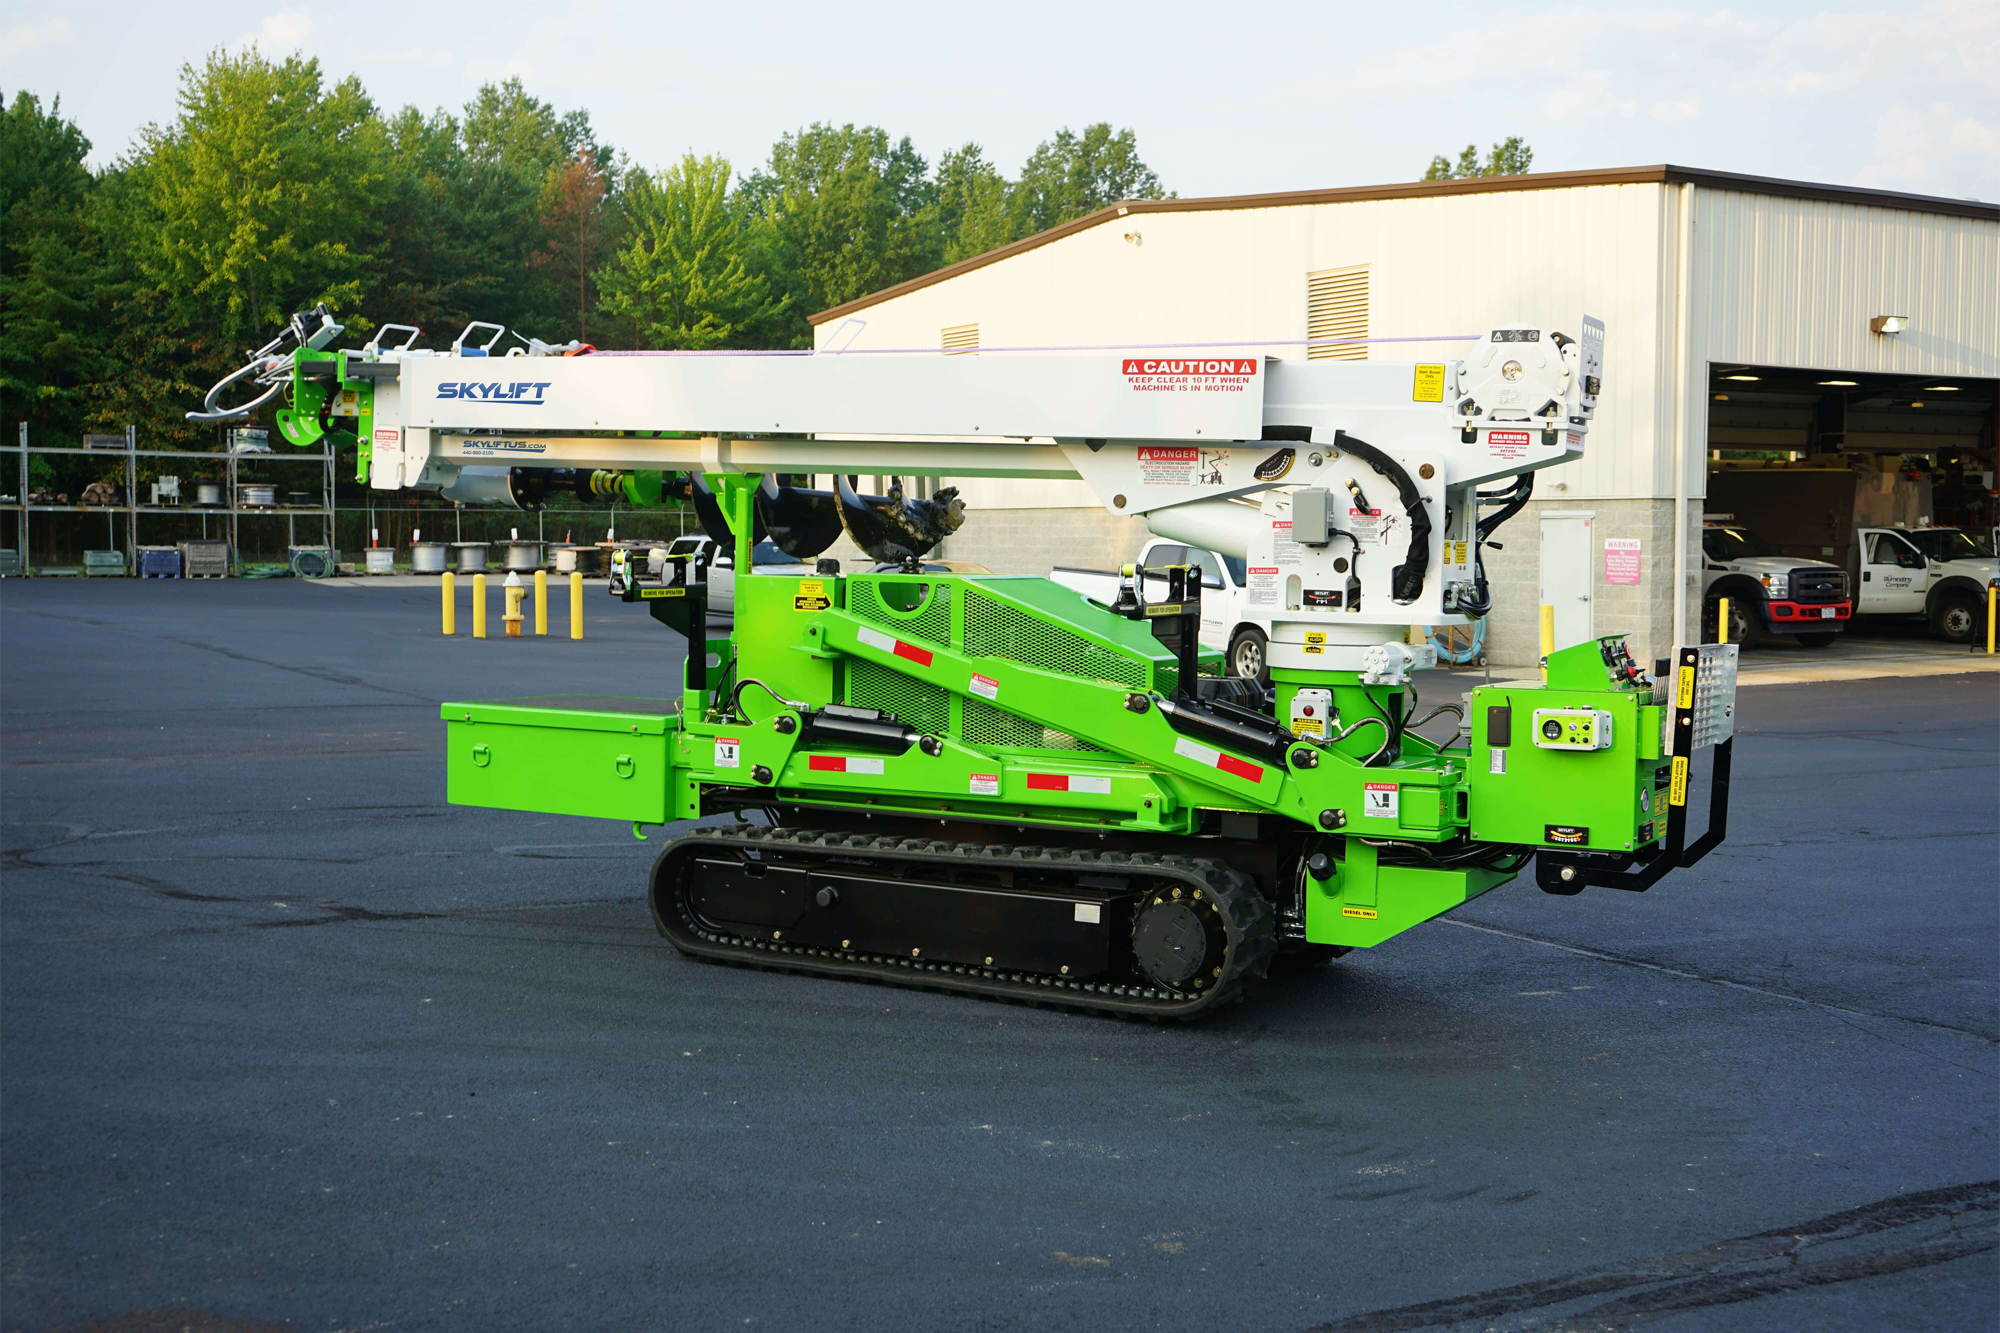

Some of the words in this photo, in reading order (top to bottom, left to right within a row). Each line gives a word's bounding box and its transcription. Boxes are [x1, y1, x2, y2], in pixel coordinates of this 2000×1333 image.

[1143, 361, 1235, 373] CAUTION
[436, 382, 552, 399] SKYLIFT
[463, 440, 546, 449] SKYLIFTUS.COM
[1154, 450, 1197, 458] DANGER
[1608, 541, 1638, 549] WARNING
[979, 676, 997, 685] DANGER
